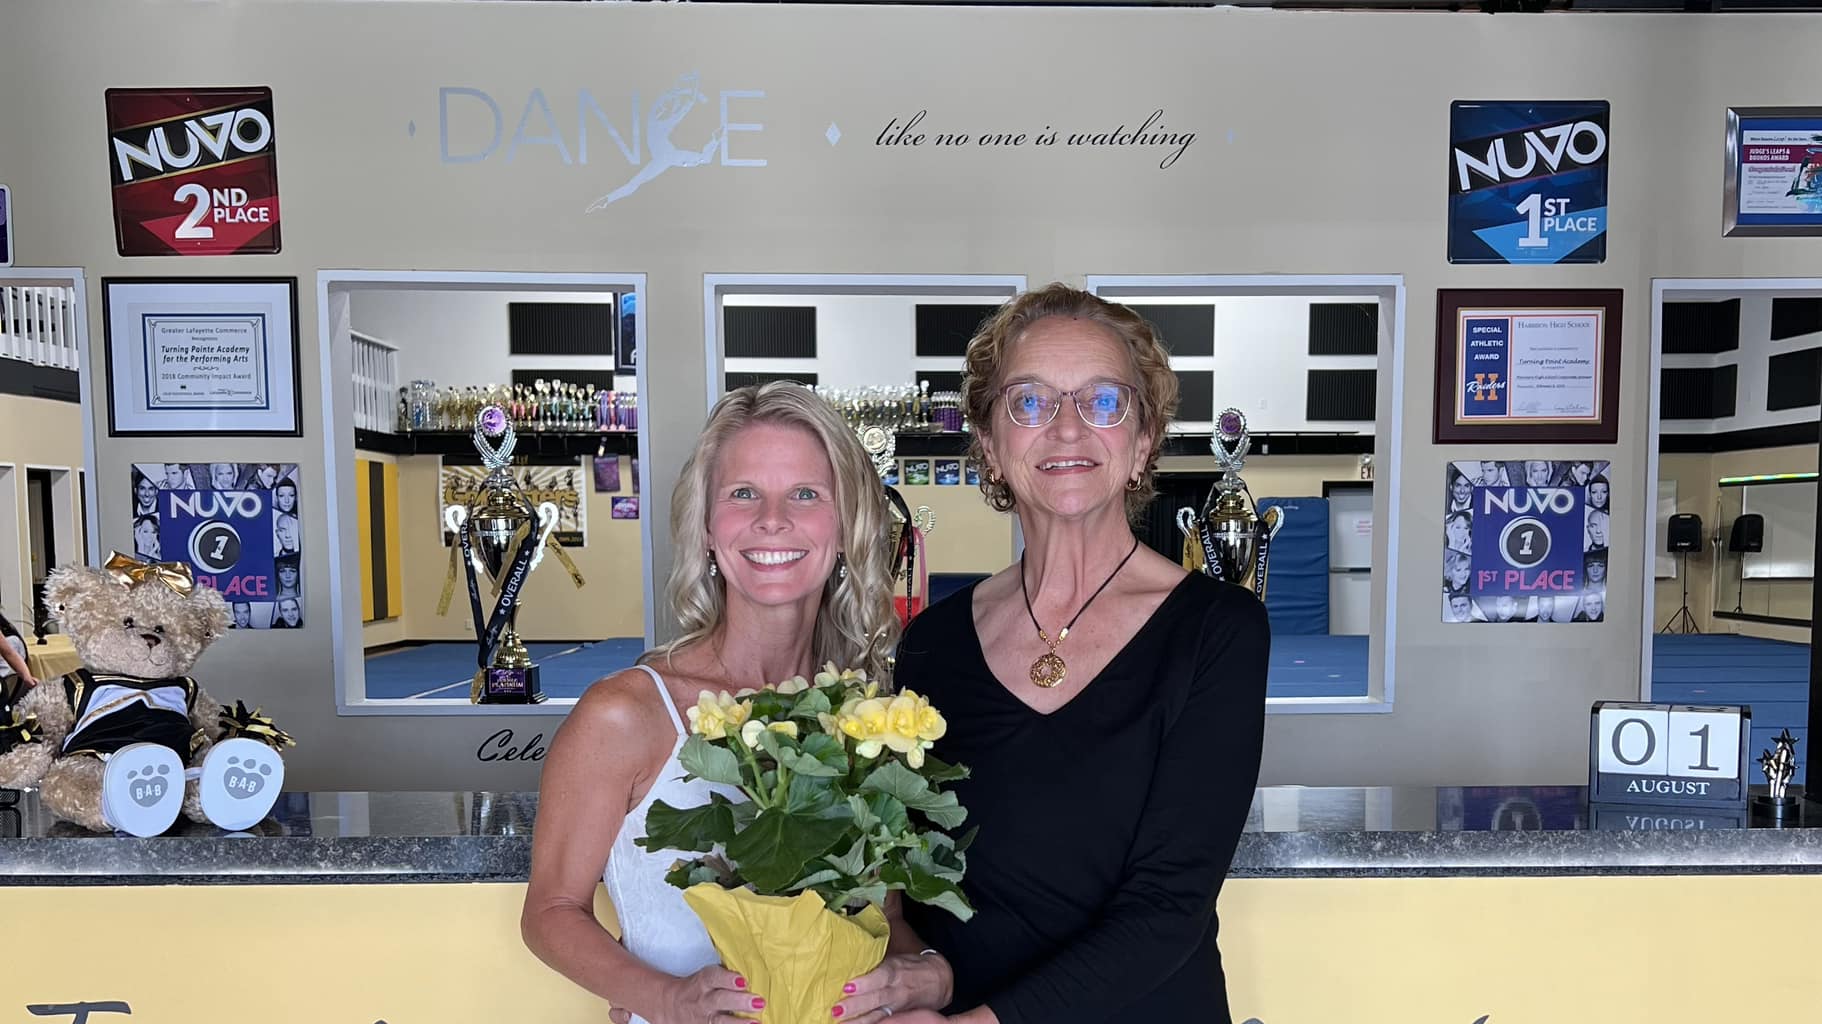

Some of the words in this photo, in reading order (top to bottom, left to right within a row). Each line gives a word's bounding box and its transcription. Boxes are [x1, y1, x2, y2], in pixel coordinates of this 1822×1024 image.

[439, 70, 767, 185] DANCE
[876, 109, 927, 147] like
[936, 131, 970, 147] no
[979, 131, 1026, 147] one
[1036, 125, 1057, 147] is
[1068, 108, 1199, 170] watching
[113, 108, 272, 181] NUVO
[1455, 121, 1606, 190] NUVO
[214, 207, 270, 223] PLACE
[1544, 217, 1597, 231] PLACE
[161, 345, 189, 354] Turning
[191, 345, 215, 353] Pointe
[216, 345, 250, 354] Academy
[163, 355, 174, 364] for
[190, 355, 231, 364] Performing
[177, 373, 210, 381] Community
[170, 491, 263, 519] NUVO
[1484, 488, 1574, 514] NUVO
[210, 535, 229, 561] 1
[1200, 524, 1222, 575] OVERALL
[1519, 530, 1534, 555] 1
[1256, 542, 1268, 594] OVERALL
[1478, 570, 1498, 591] 1ST
[1504, 570, 1575, 591] PLACE
[501, 560, 528, 608] OVERALL
[477, 729, 546, 762] Cele
[1626, 779, 1710, 795] AUGUST
